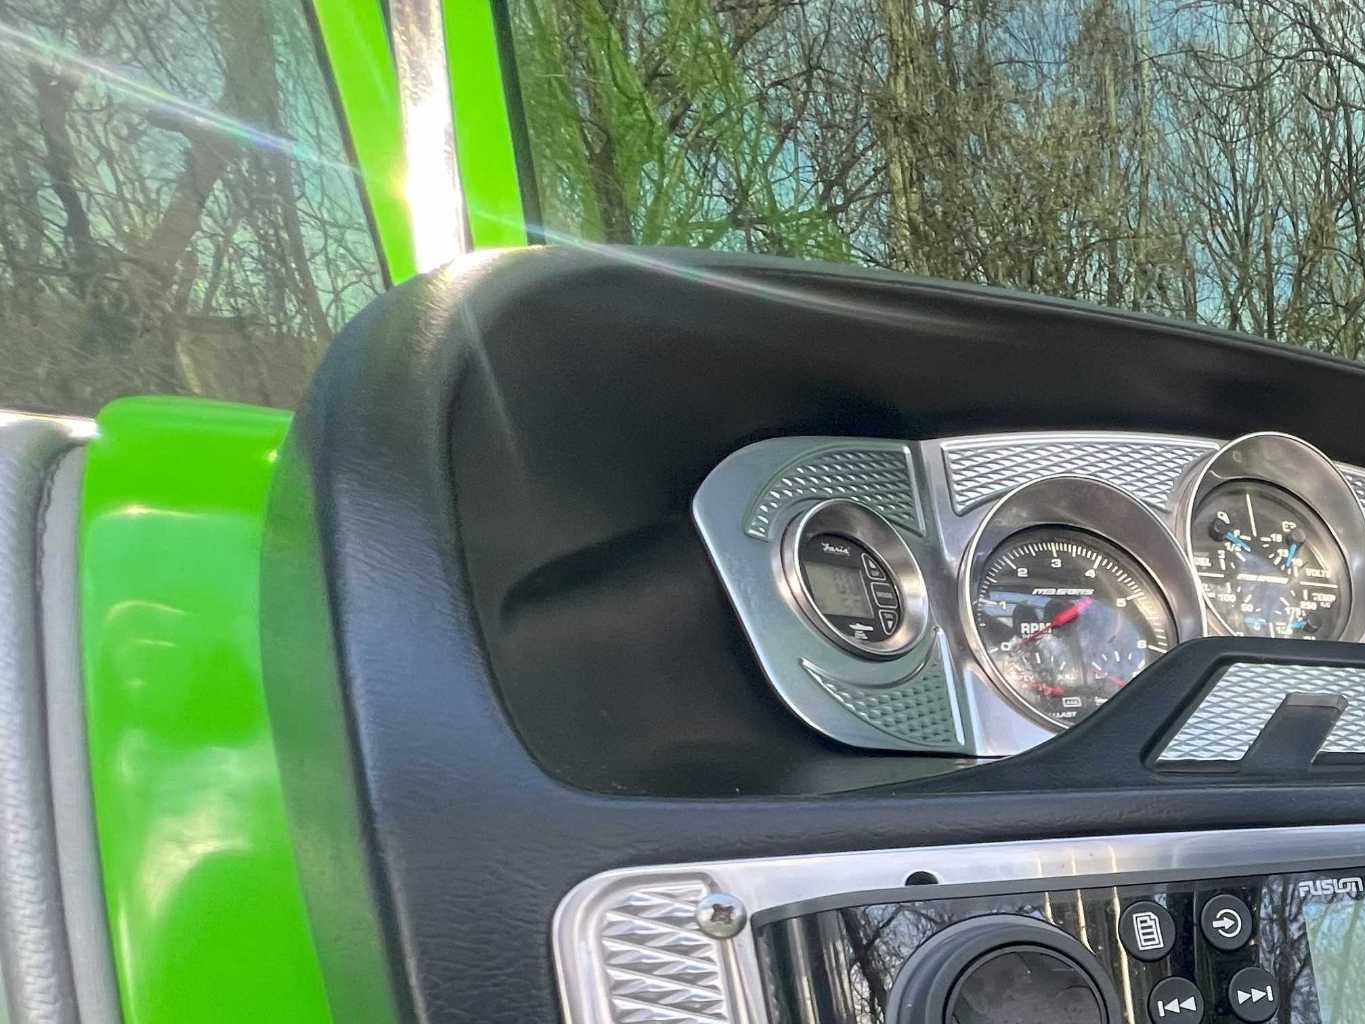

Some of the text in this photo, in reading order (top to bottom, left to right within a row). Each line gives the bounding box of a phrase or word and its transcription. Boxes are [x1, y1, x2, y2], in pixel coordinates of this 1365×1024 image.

[1051, 558, 1062, 568] 3
[1017, 568, 1029, 577] 2
[1085, 569, 1097, 578] 4
[1116, 598, 1127, 608] 5
[1020, 622, 1053, 634] RPM
